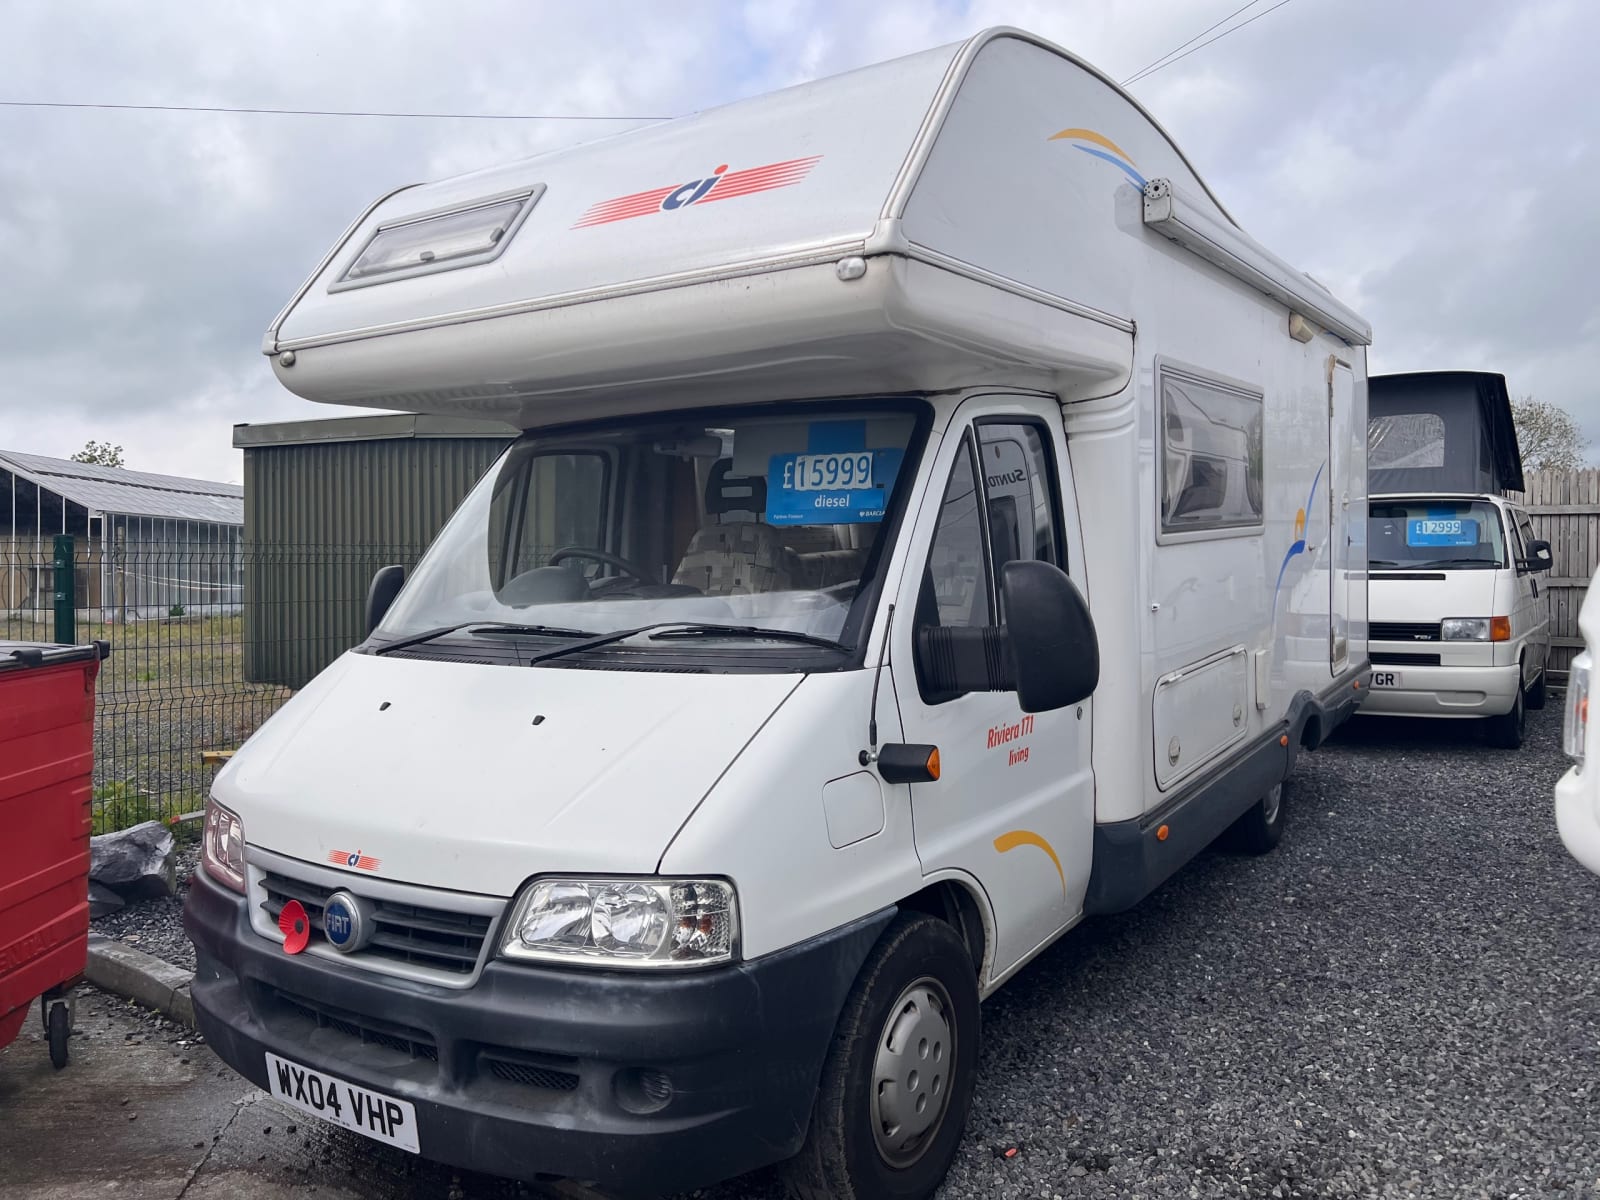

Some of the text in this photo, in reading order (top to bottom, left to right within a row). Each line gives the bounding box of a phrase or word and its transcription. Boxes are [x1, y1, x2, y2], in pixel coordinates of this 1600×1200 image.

[783, 454, 871, 489] £15999
[814, 494, 850, 508] diesel
[1415, 521, 1461, 535] £12999
[987, 723, 1020, 749] Riviera
[1008, 746, 1030, 767] living
[326, 912, 350, 935] FIAT
[275, 1060, 405, 1138] WX04 VHP
